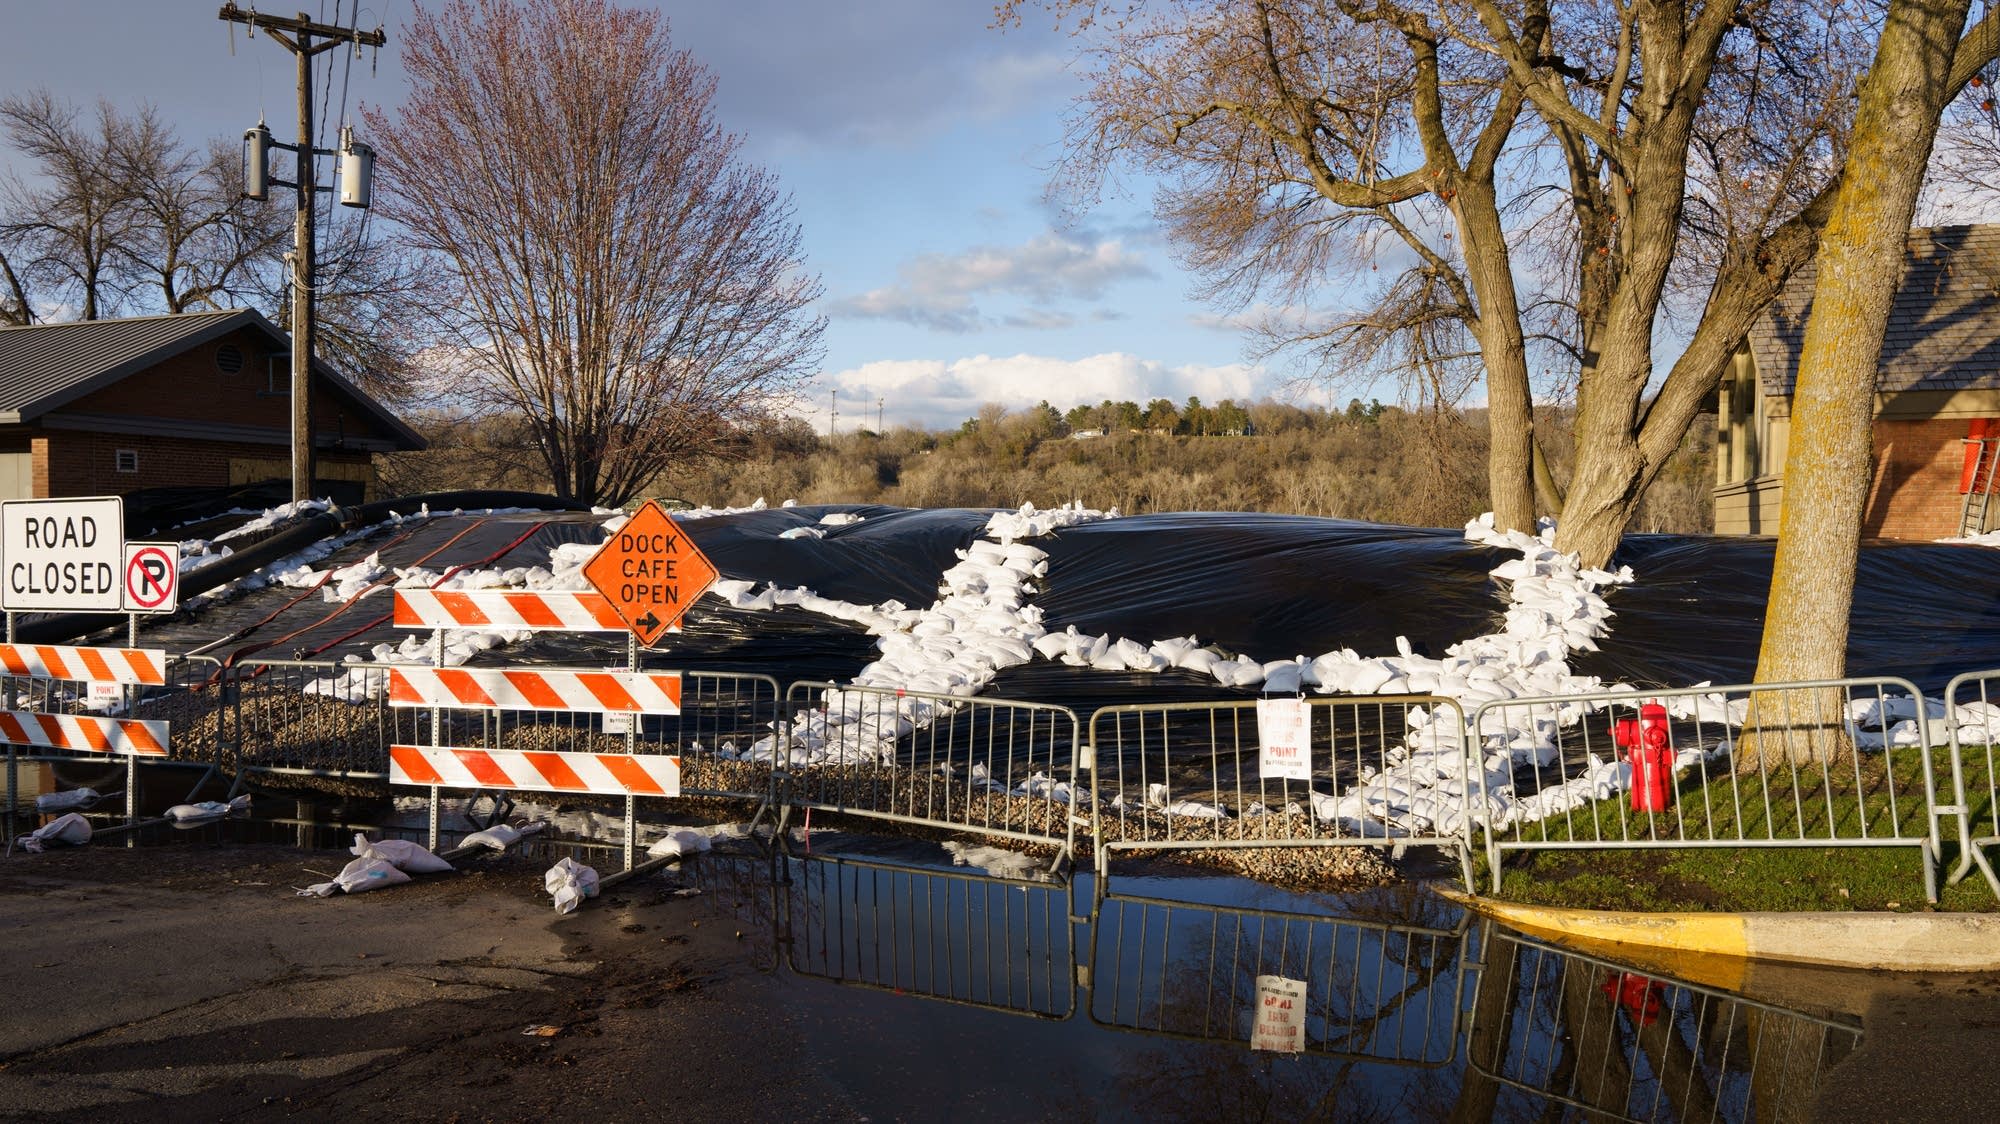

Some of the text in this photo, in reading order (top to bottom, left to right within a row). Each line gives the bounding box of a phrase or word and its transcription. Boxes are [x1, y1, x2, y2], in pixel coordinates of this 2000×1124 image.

[25, 516, 97, 549] ROAD
[621, 534, 678, 554] DOCK
[11, 561, 113, 595] CLOSED
[141, 559, 166, 596] P
[621, 558, 678, 580] CAFE
[621, 583, 678, 605] OPEN
[95, 686, 115, 695] POINT
[1269, 746, 1298, 758] POINT
